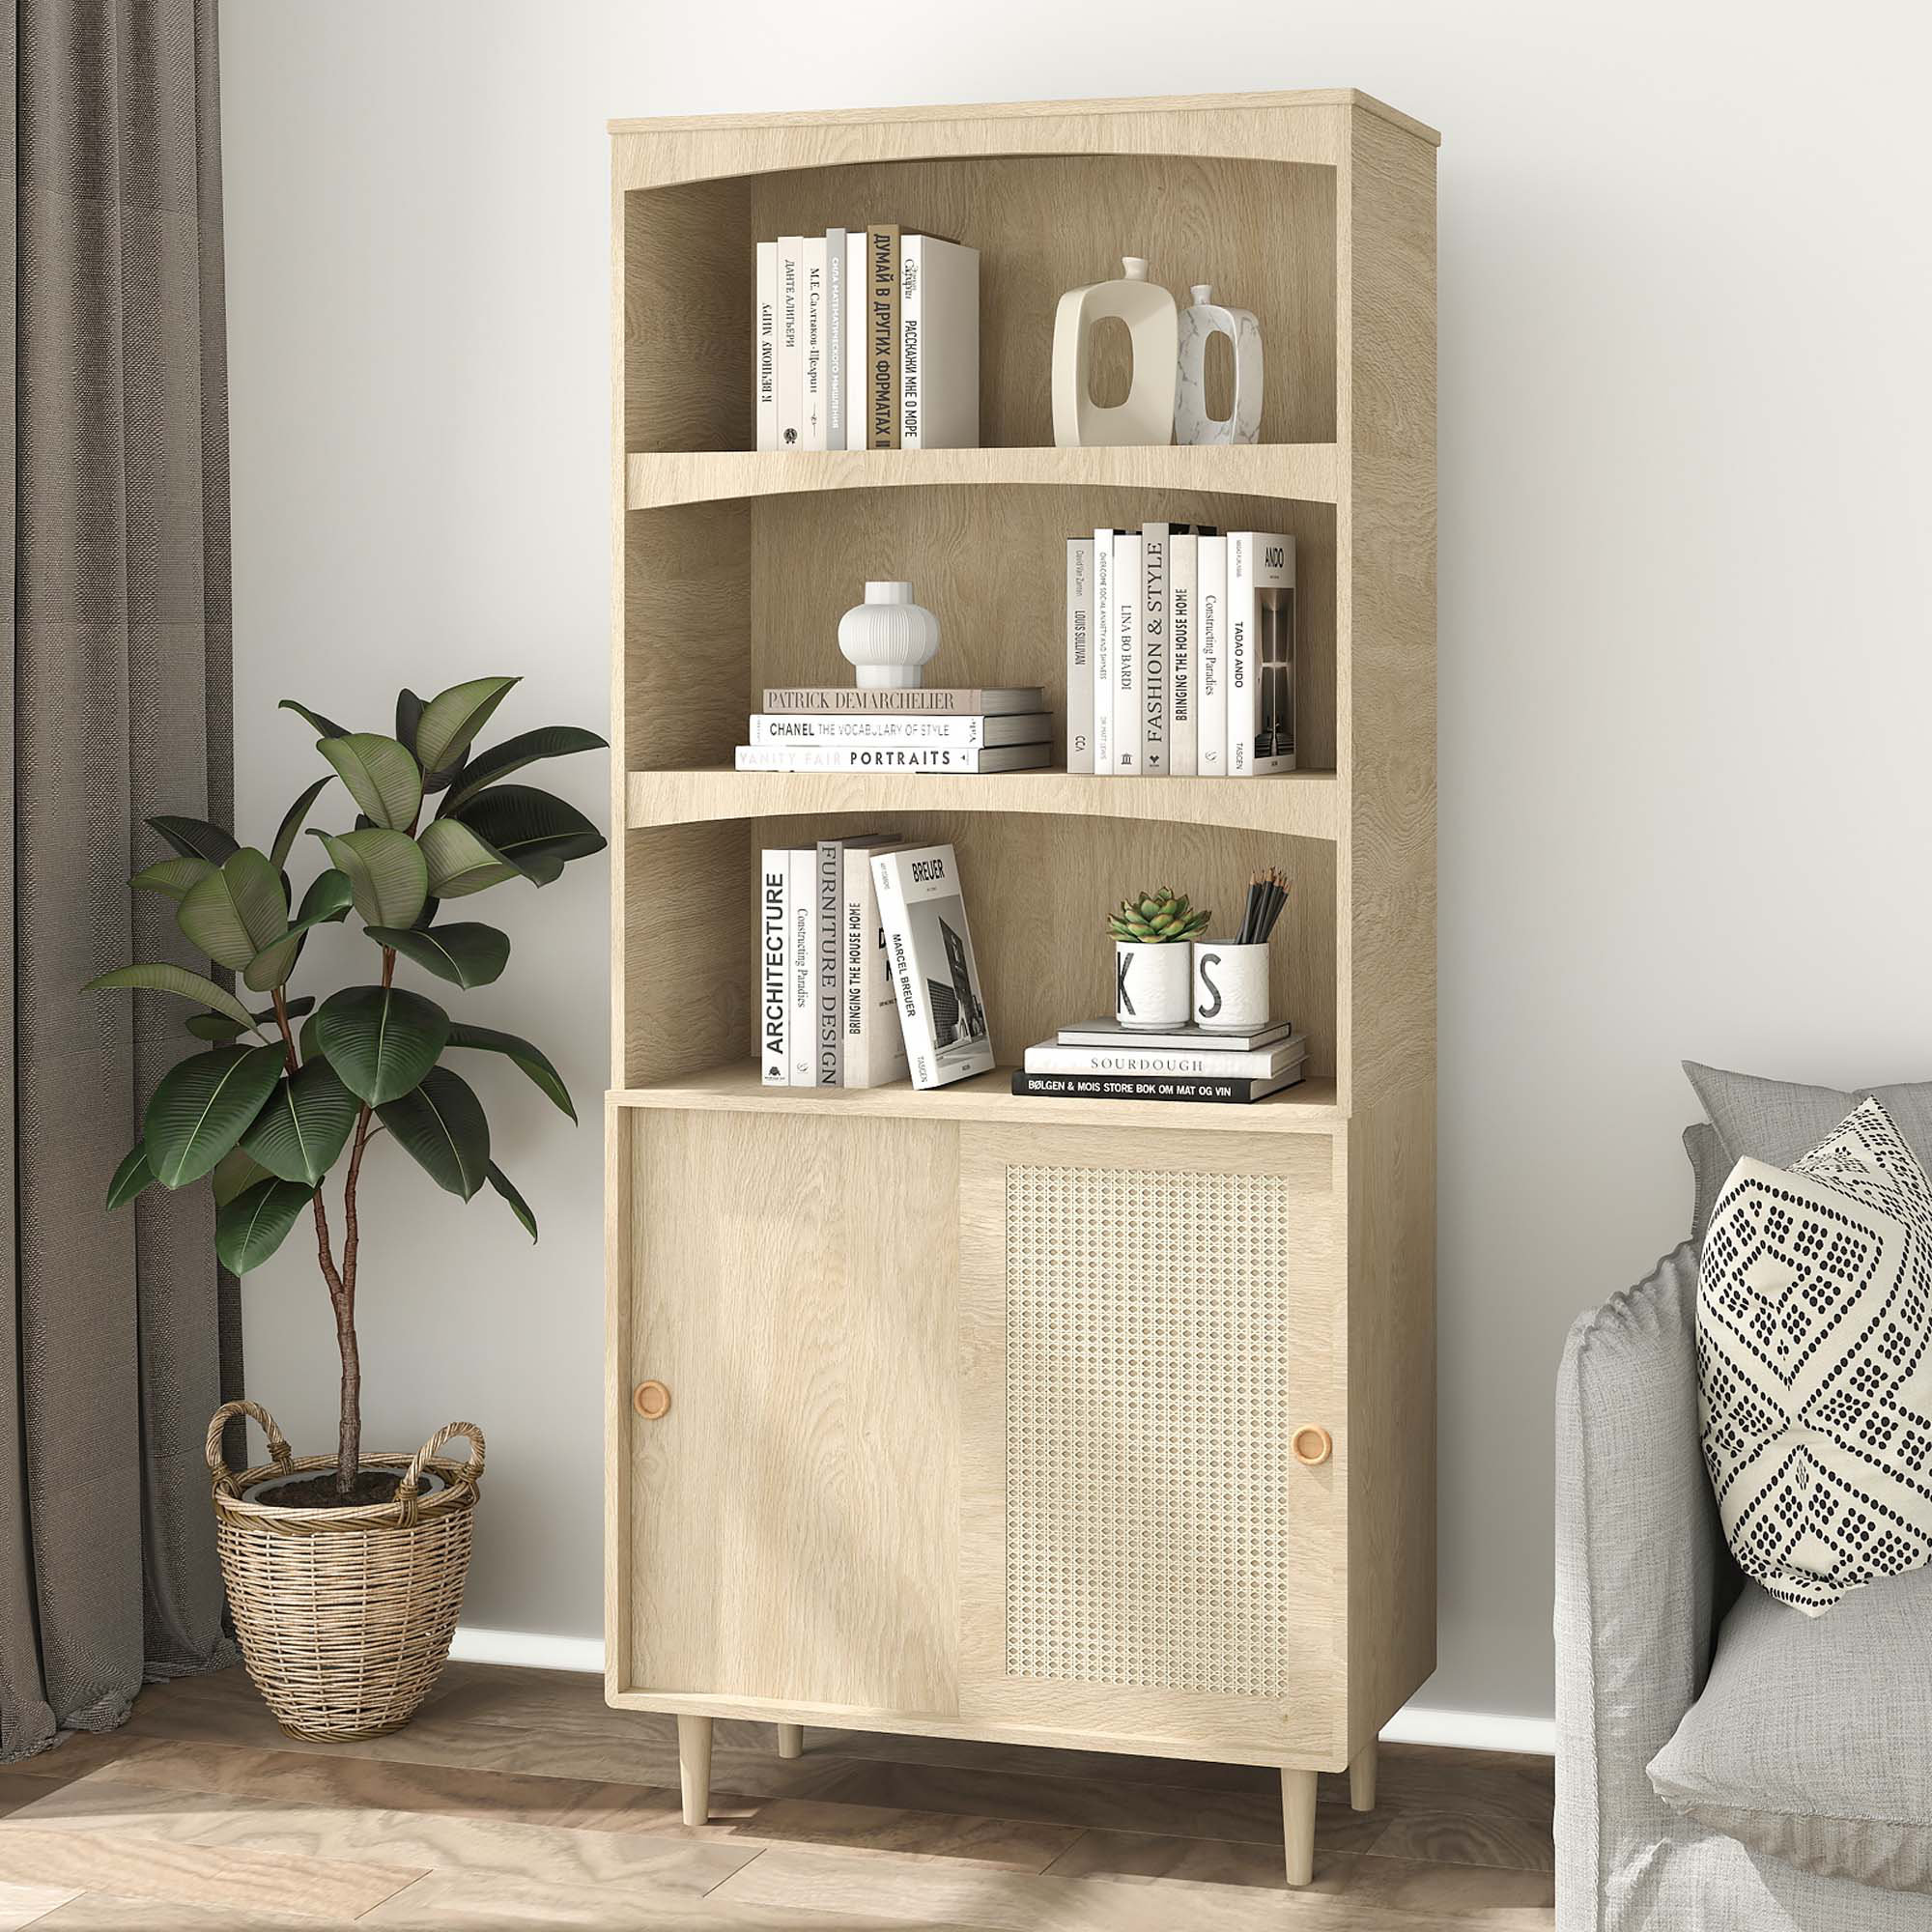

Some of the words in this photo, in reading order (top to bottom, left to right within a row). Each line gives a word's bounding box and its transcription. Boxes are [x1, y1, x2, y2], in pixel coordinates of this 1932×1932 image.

[873, 234, 895, 283] ДУМАЙ
[784, 259, 795, 294] ДАНТЕ
[875, 288, 891, 297] В
[784, 296, 796, 348] АЛИГЬЕРИ
[873, 301, 891, 355] ДРУГИХ
[904, 320, 918, 374] РАССКАЖИ
[761, 341, 773, 392] ВЕЧНОМУ
[875, 360, 891, 435] ФОРМАТАХ
[904, 376, 918, 397] МНЕ
[904, 411, 918, 438] МОРЕ
[1098, 552, 1107, 586] OVERCOME
[1264, 547, 1285, 568] ANDO
[1147, 542, 1163, 612] STYLE
[1098, 587, 1107, 609] SOCIAL
[1175, 588, 1188, 616] HOME
[1074, 610, 1086, 631] LOUIS
[1098, 611, 1107, 637] ANXIETY
[1121, 605, 1132, 633] LINA
[1147, 618, 1163, 634] &
[1175, 620, 1188, 650] HOUSE
[1203, 595, 1217, 655] Constructing
[1074, 632, 1086, 666] SULLIVAN
[1098, 638, 1107, 652] AND
[1121, 635, 1132, 652] BO
[1235, 621, 1244, 657] TADAO
[1121, 654, 1132, 691] BARDI
[1175, 651, 1188, 671] THE
[1206, 657, 1217, 696] Paradies
[1235, 658, 1244, 689] ANDO
[768, 691, 829, 709] PATRICK
[835, 691, 954, 710] DEMARCHELIER
[1147, 642, 1163, 743] FASHION
[1175, 673, 1188, 722] BRINGING
[769, 723, 815, 736] CHANEL
[818, 724, 836, 735] THE
[838, 724, 903, 736] VOCABULARY
[904, 724, 919, 736] OF
[921, 724, 951, 736] STYLE
[1074, 735, 1086, 753] CCA
[740, 752, 796, 766] VANITY
[805, 753, 841, 766] FAIR
[850, 751, 951, 766] PORTRAITS
[911, 859, 946, 883] BREUER
[821, 845, 837, 987] FURNITURE
[849, 902, 861, 930] HOME
[795, 908, 809, 967] Constructing
[849, 932, 861, 965] HOUSE
[766, 872, 783, 1055] ARCHITECTURE
[849, 966, 861, 986] THE
[892, 933, 908, 975] MARCEL
[900, 976, 917, 1017] BREUER
[1117, 952, 1137, 1016] K
[1198, 952, 1222, 1018] S
[849, 987, 861, 1035] BRINGING
[821, 996, 837, 1085] DESIGN
[1090, 1057, 1204, 1072] SOURDOUGH
[1028, 1079, 1065, 1092] BØLGEN
[1066, 1080, 1075, 1092] &
[1077, 1081, 1101, 1093] MOIS
[1103, 1082, 1135, 1094] STORE
[1136, 1083, 1156, 1094] BOK
[1158, 1084, 1174, 1094] OM
[1176, 1084, 1196, 1095] MAT
[1198, 1085, 1213, 1096] OG
[1214, 1086, 1232, 1097] VIN
